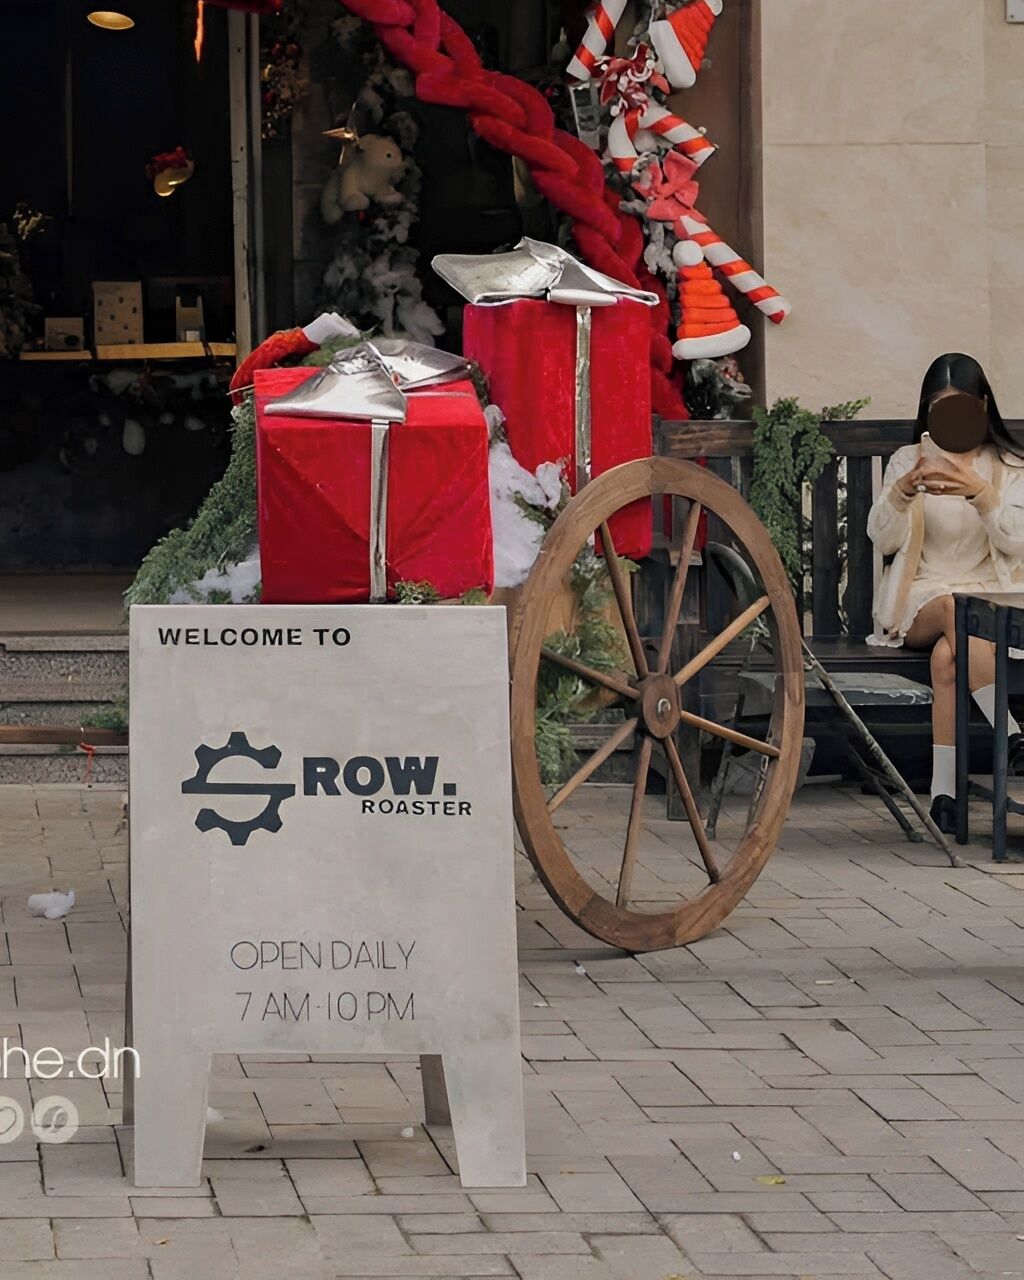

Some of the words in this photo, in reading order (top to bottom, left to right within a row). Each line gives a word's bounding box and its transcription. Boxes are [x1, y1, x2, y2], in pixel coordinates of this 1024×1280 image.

[158, 627, 303, 647] WELCOME
[312, 627, 352, 647] TO
[360, 799, 473, 817] ROASTER
[230, 940, 322, 970] OPEN
[331, 940, 417, 970] DAILY
[235, 991, 253, 1021] 7
[366, 991, 416, 1021] PM
